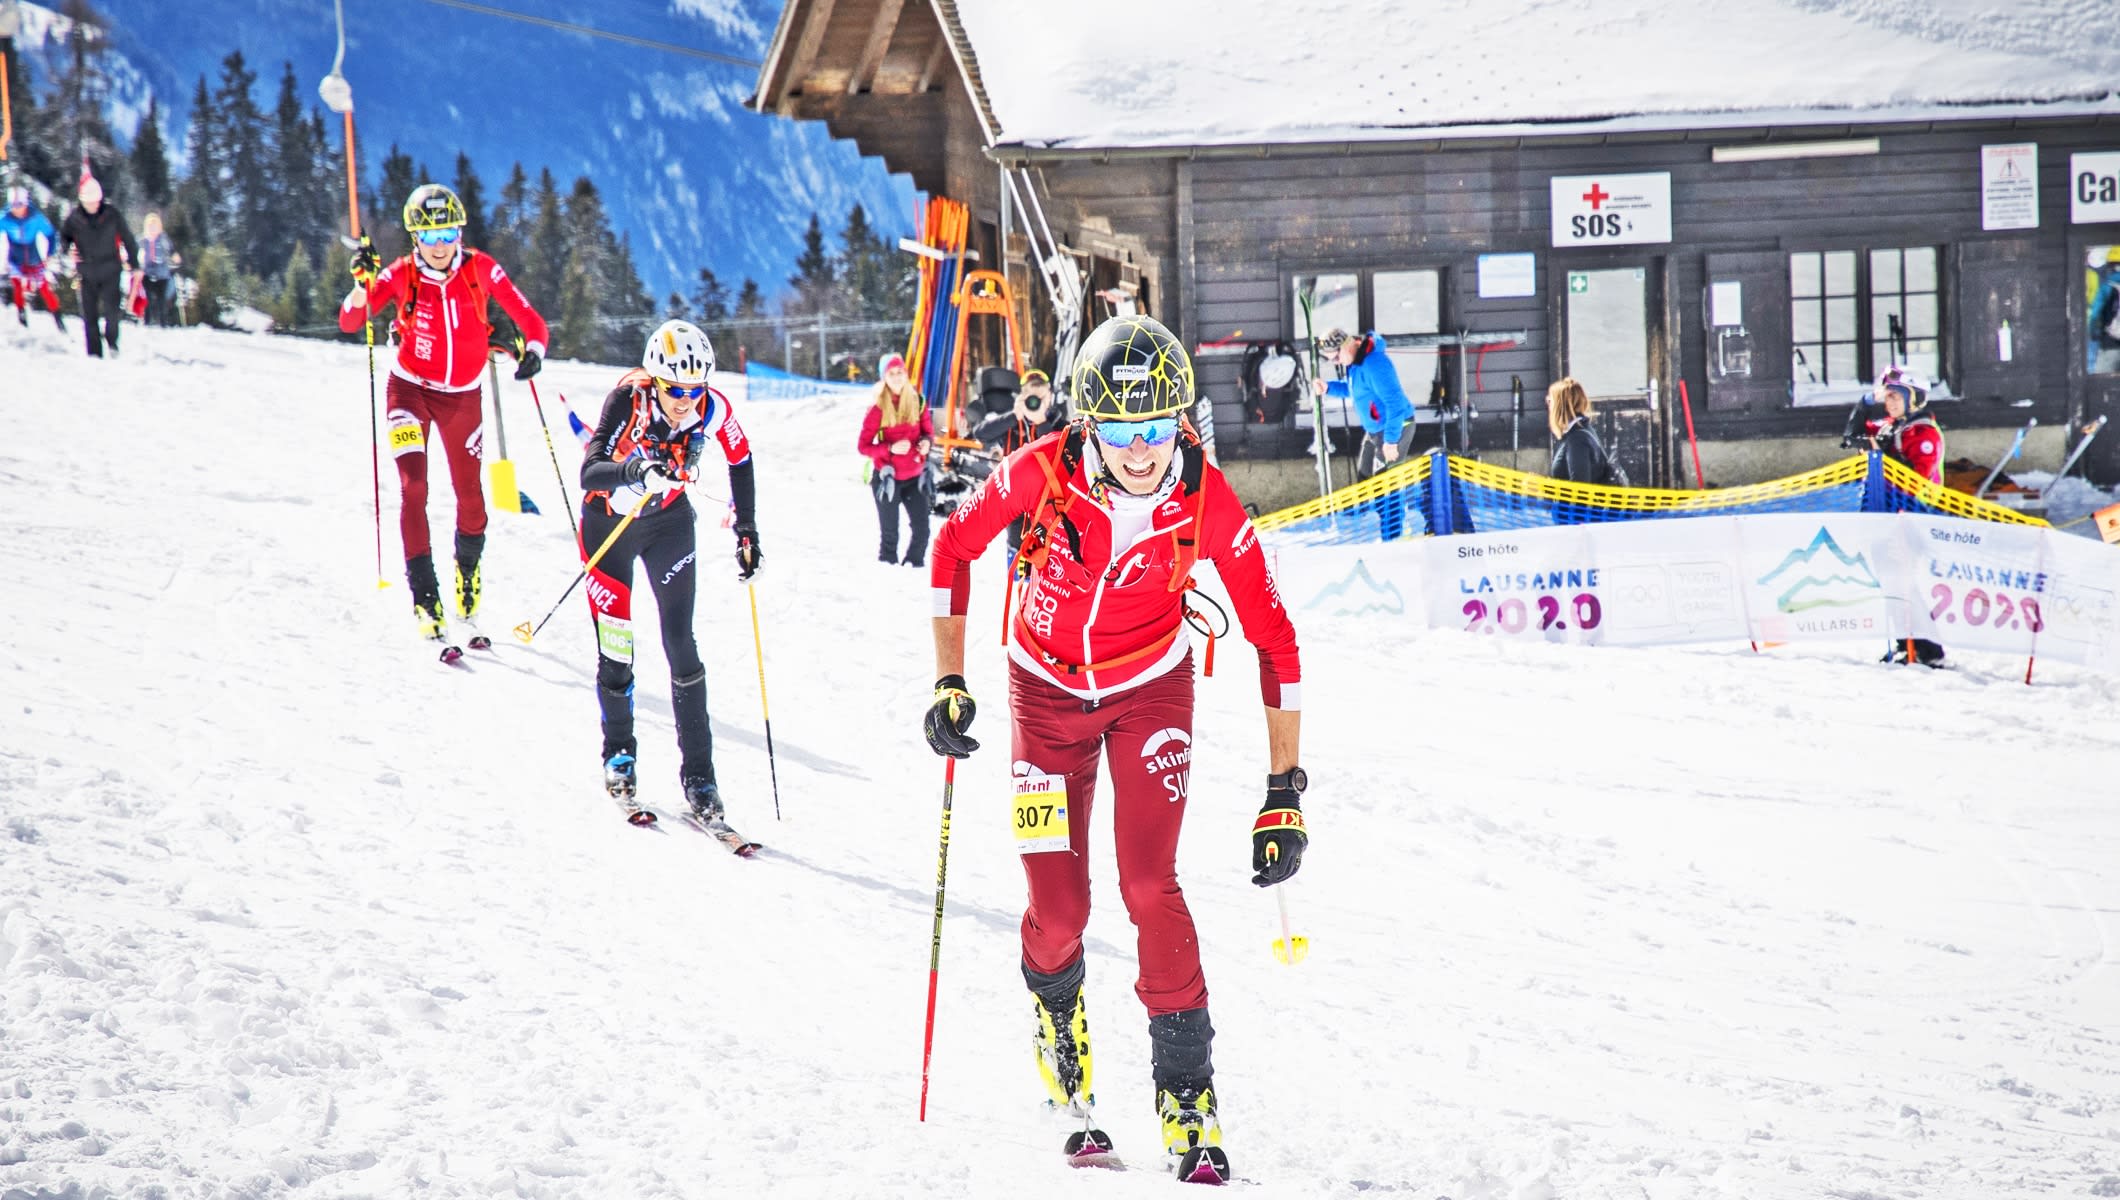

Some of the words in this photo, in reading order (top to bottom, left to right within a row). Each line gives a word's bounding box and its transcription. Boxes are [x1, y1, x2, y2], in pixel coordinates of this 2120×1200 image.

[2078, 171, 2120, 203] Ca
[1572, 213, 1621, 238] SOS
[1114, 391, 1149, 399] CAMP
[394, 431, 418, 444] 306
[1234, 534, 1256, 558] skin
[1934, 528, 1951, 542] Site
[672, 551, 697, 573] SPOR
[1458, 546, 1484, 559] Site
[1488, 543, 1519, 556] hôte
[1460, 568, 1600, 594] LAUSANNE
[1930, 559, 2048, 592] LAUSANNE
[584, 573, 618, 613] ANCE
[1038, 577, 1071, 598] ARMIN
[1796, 618, 1858, 632] VILLARS
[604, 632, 627, 649] 106
[1146, 747, 1191, 775] skinfi
[1016, 805, 1054, 829] 307
